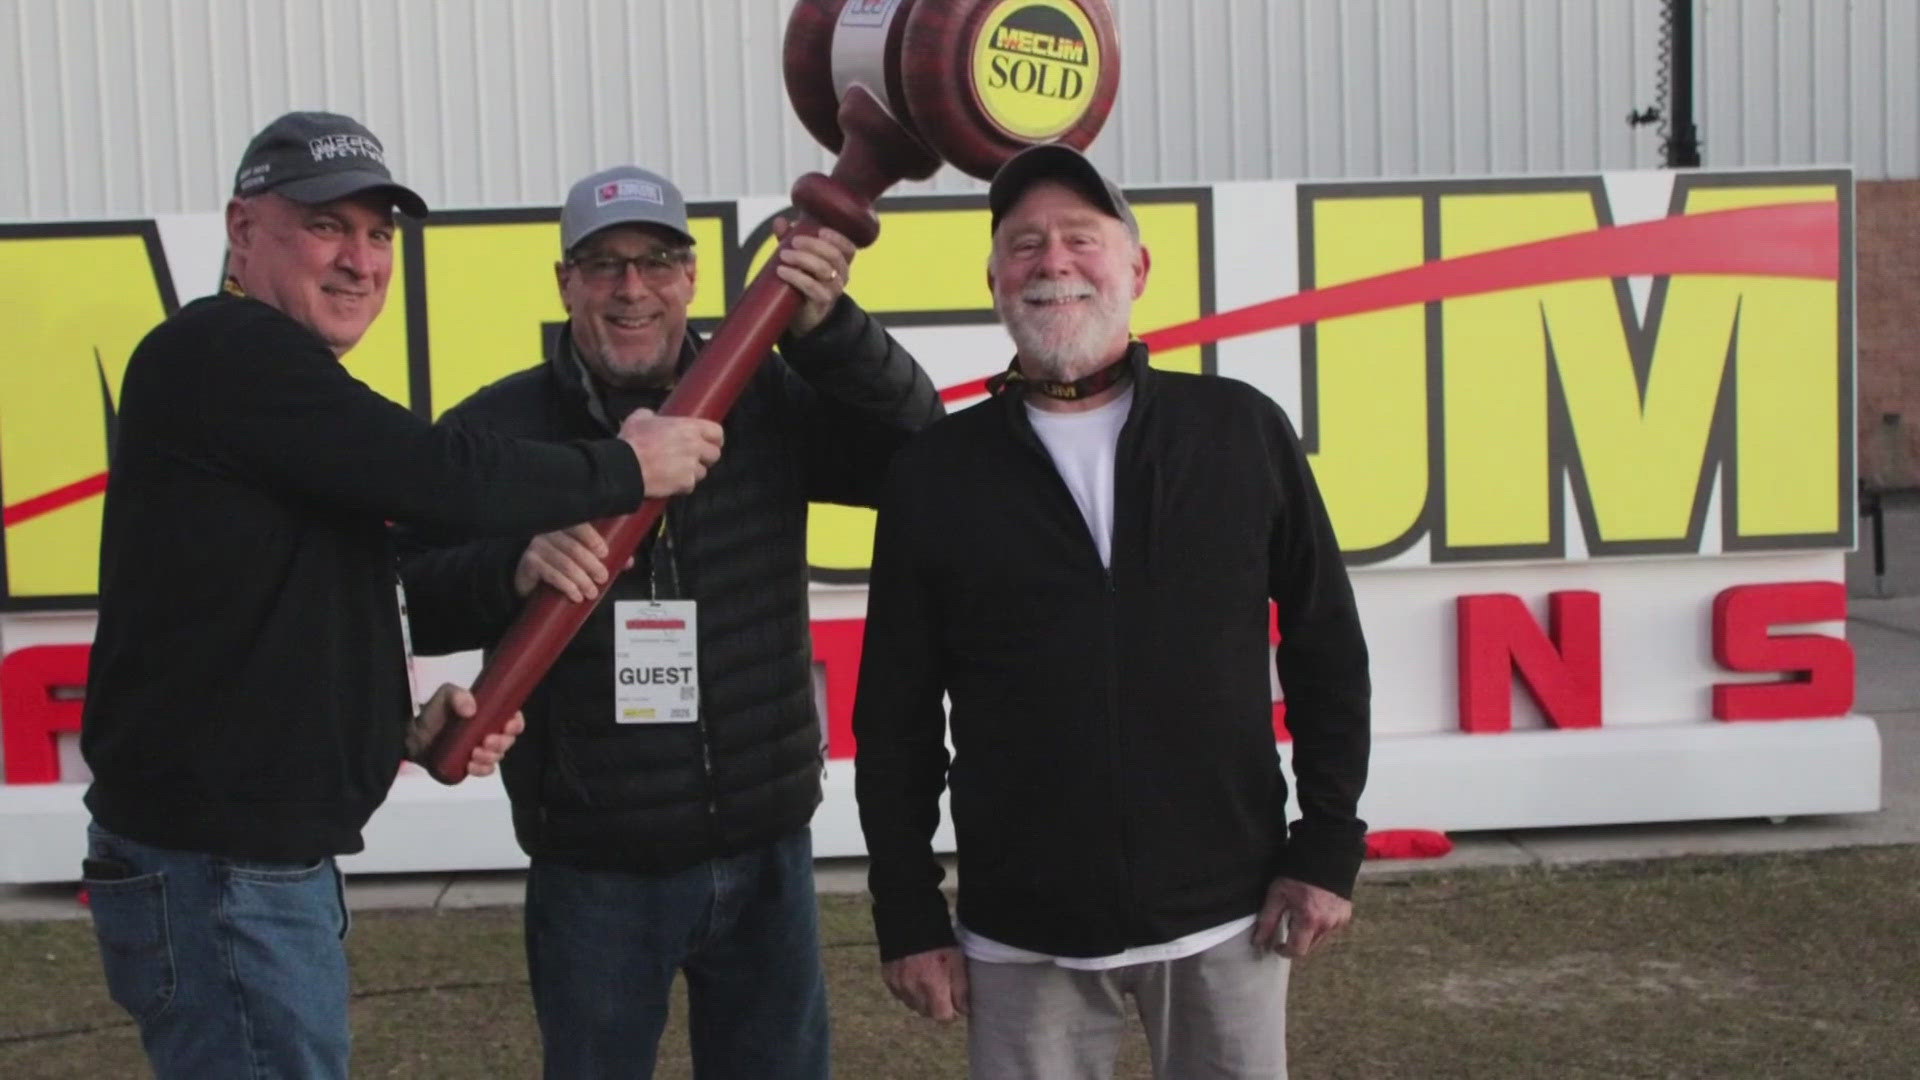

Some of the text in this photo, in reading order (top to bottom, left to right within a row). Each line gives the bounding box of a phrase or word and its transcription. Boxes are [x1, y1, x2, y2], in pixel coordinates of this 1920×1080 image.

[997, 26, 1084, 62] MECUM
[988, 54, 1083, 100] SOLD
[619, 667, 693, 685] GUEST
